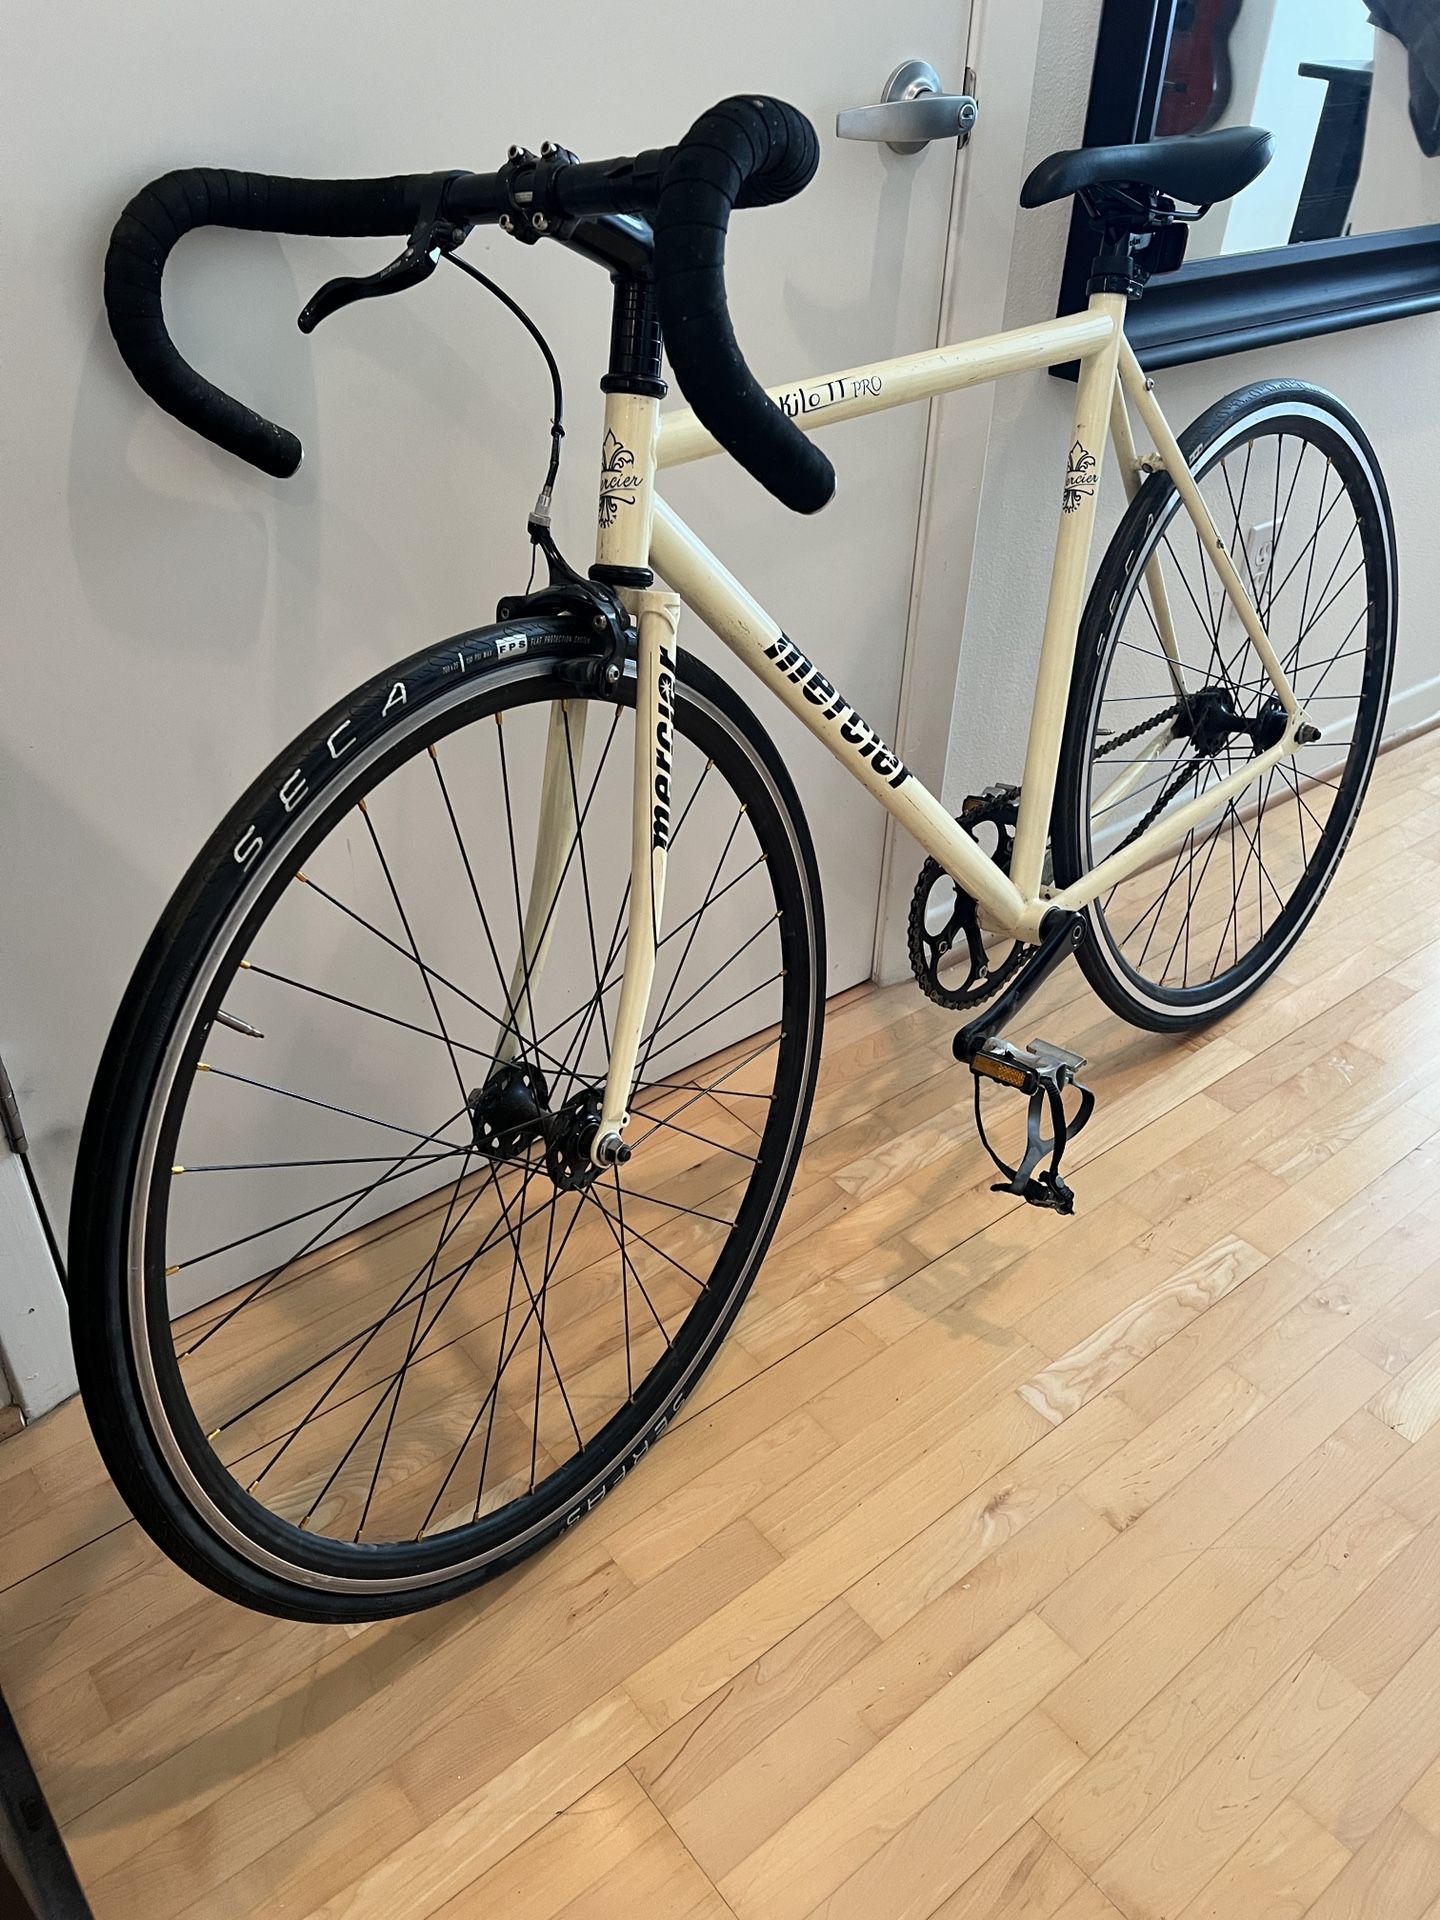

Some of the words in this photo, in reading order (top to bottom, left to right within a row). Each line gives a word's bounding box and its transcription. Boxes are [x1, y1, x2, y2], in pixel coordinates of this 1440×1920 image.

[499, 640, 527, 654] FPS
[764, 629, 913, 790] mercier
[233, 681, 409, 873] SECA
[653, 645, 677, 850] mercier
